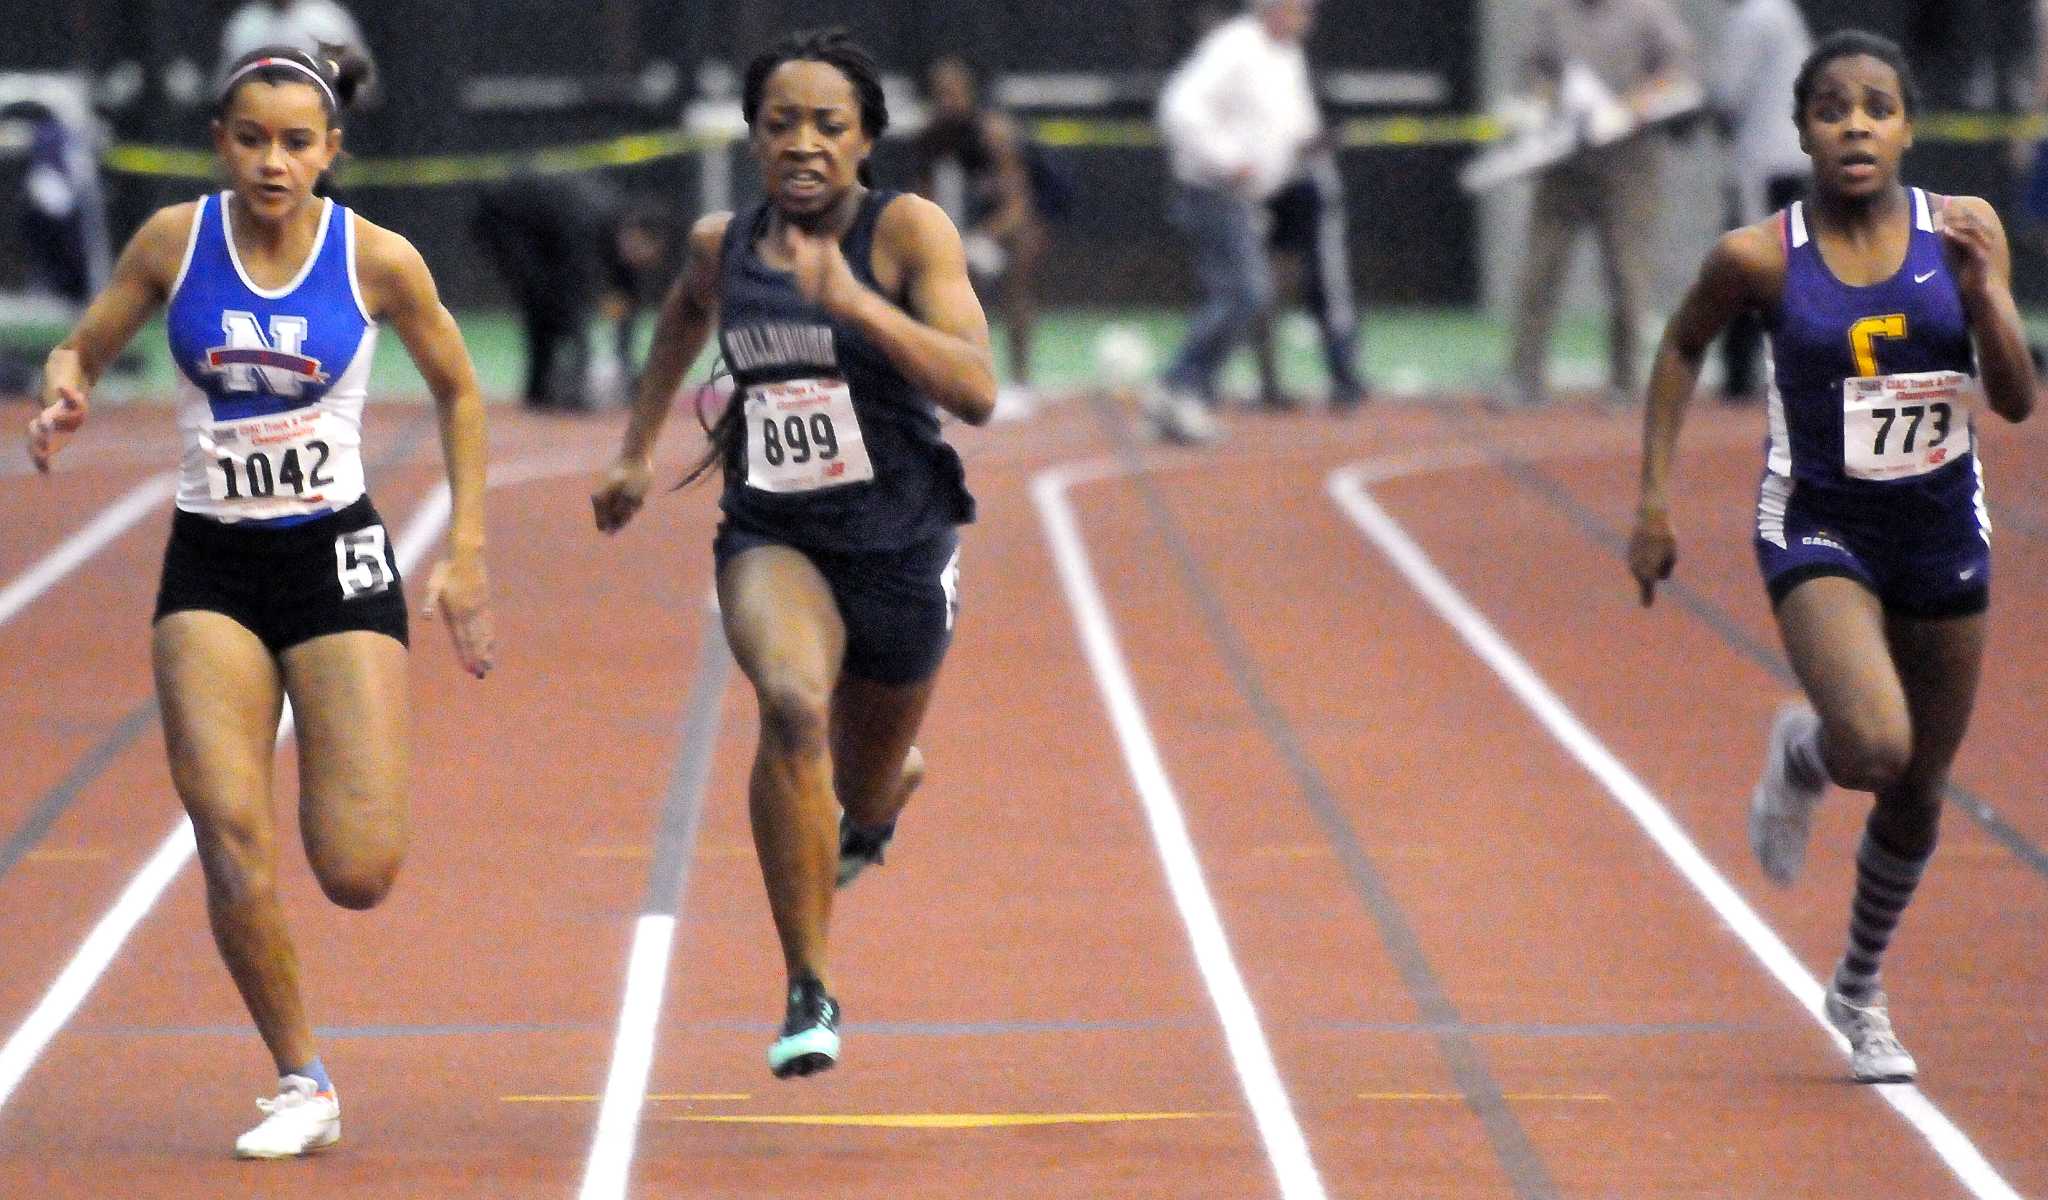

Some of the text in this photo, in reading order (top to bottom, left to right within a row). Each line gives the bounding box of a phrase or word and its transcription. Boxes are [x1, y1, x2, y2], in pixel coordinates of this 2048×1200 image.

[222, 309, 308, 397] N
[763, 412, 839, 466] 899
[1872, 402, 1952, 455] 773
[217, 441, 335, 500] 1042
[343, 534, 386, 595] 5
